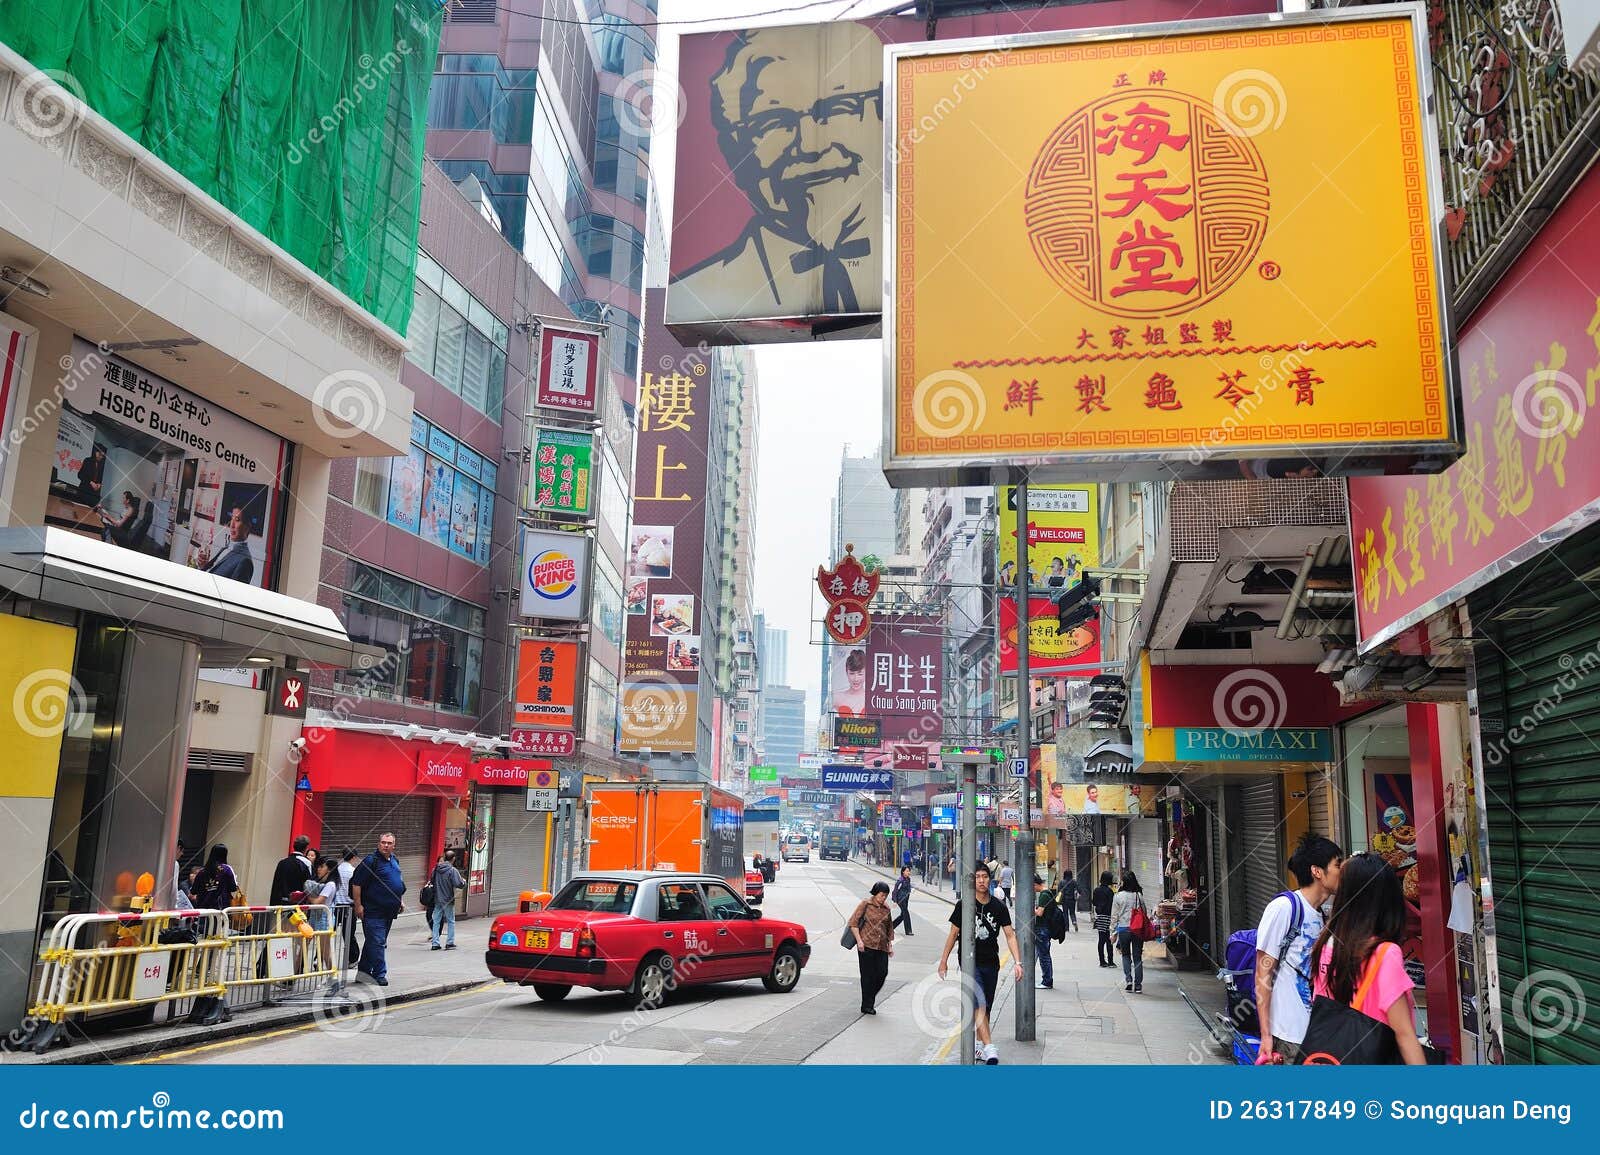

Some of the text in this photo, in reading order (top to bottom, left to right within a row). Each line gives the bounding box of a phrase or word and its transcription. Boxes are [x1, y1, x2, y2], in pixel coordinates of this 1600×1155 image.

[1113, 70, 1167, 88] 正牌
[1096, 101, 1200, 299] 海天堂
[1076, 319, 1236, 350] 大家姐監製
[103, 362, 212, 427] 匯豐中小企中心
[1003, 366, 1325, 417] 鮮製龜苓膏
[99, 388, 257, 474] HSBC Business Centre
[635, 372, 697, 501] 樓上
[1040, 530, 1083, 539] WELCOME
[533, 559, 574, 575] BURGER
[534, 570, 576, 588] KING
[832, 604, 865, 638] 押
[870, 652, 937, 694] 周生生
[523, 704, 566, 713] YOSHINOYA
[870, 695, 937, 713] Chow Sang Sang
[840, 723, 876, 734] Nikon
[1185, 731, 1319, 749] PROMAXI
[427, 760, 463, 778] SmarTone
[483, 765, 528, 779] SmarTo
[825, 773, 869, 783] SUNING
[532, 800, 551, 809] 終止
[592, 816, 637, 824] KERRY
